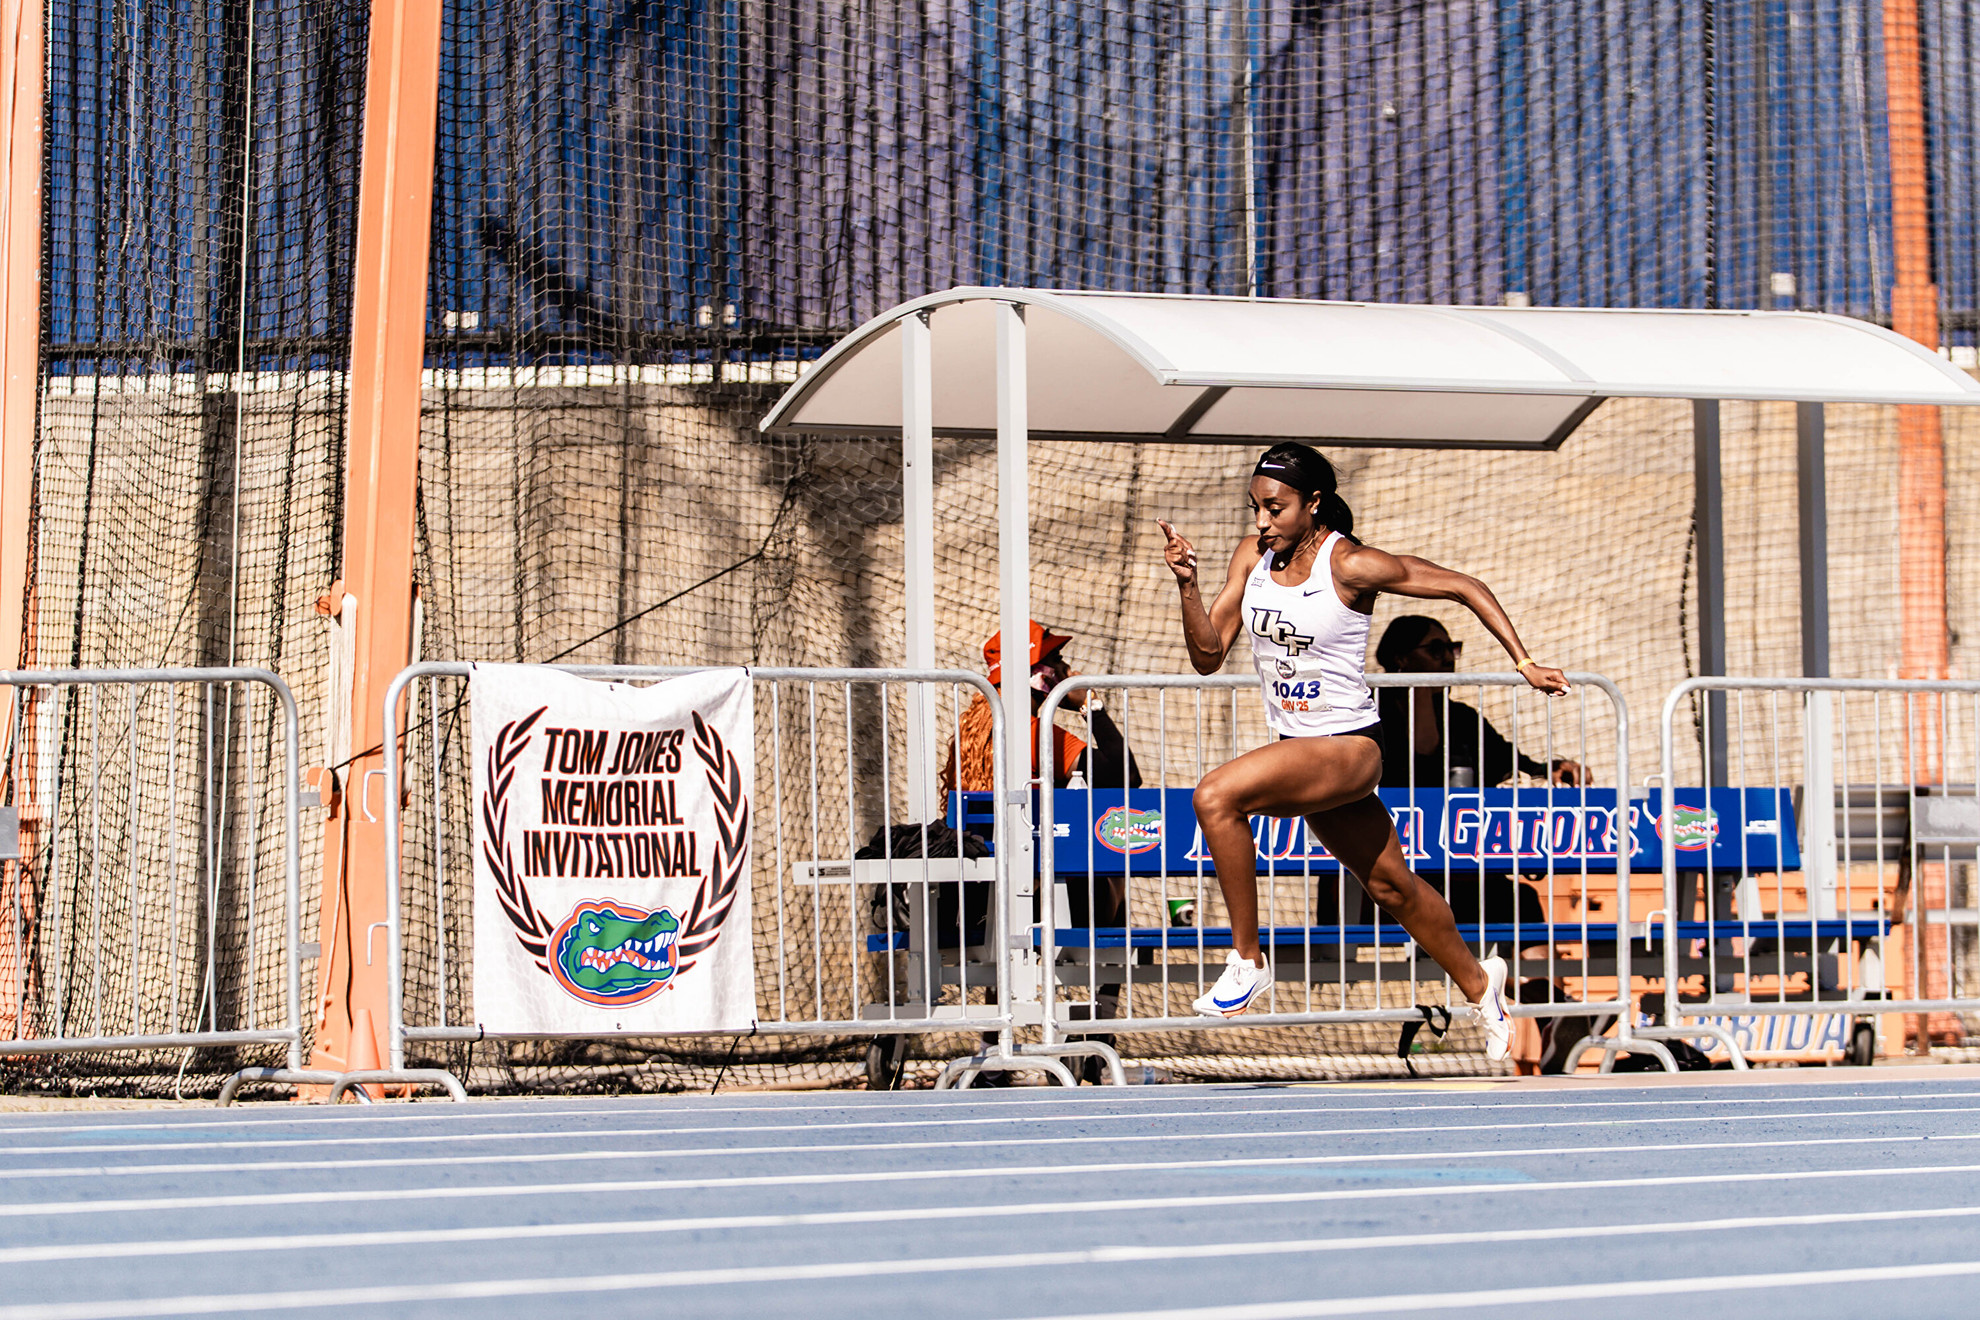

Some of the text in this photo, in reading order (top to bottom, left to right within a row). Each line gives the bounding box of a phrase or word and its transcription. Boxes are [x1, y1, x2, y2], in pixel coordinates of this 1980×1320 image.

[1251, 607, 1314, 656] UCF
[1272, 680, 1321, 699] 1043
[1281, 699, 1309, 711] GNV '25
[543, 727, 685, 775] TOM JONES
[541, 778, 684, 827] MEMORIAL
[1439, 793, 1640, 862] GATORS
[523, 830, 702, 878] INVITATIONAL
